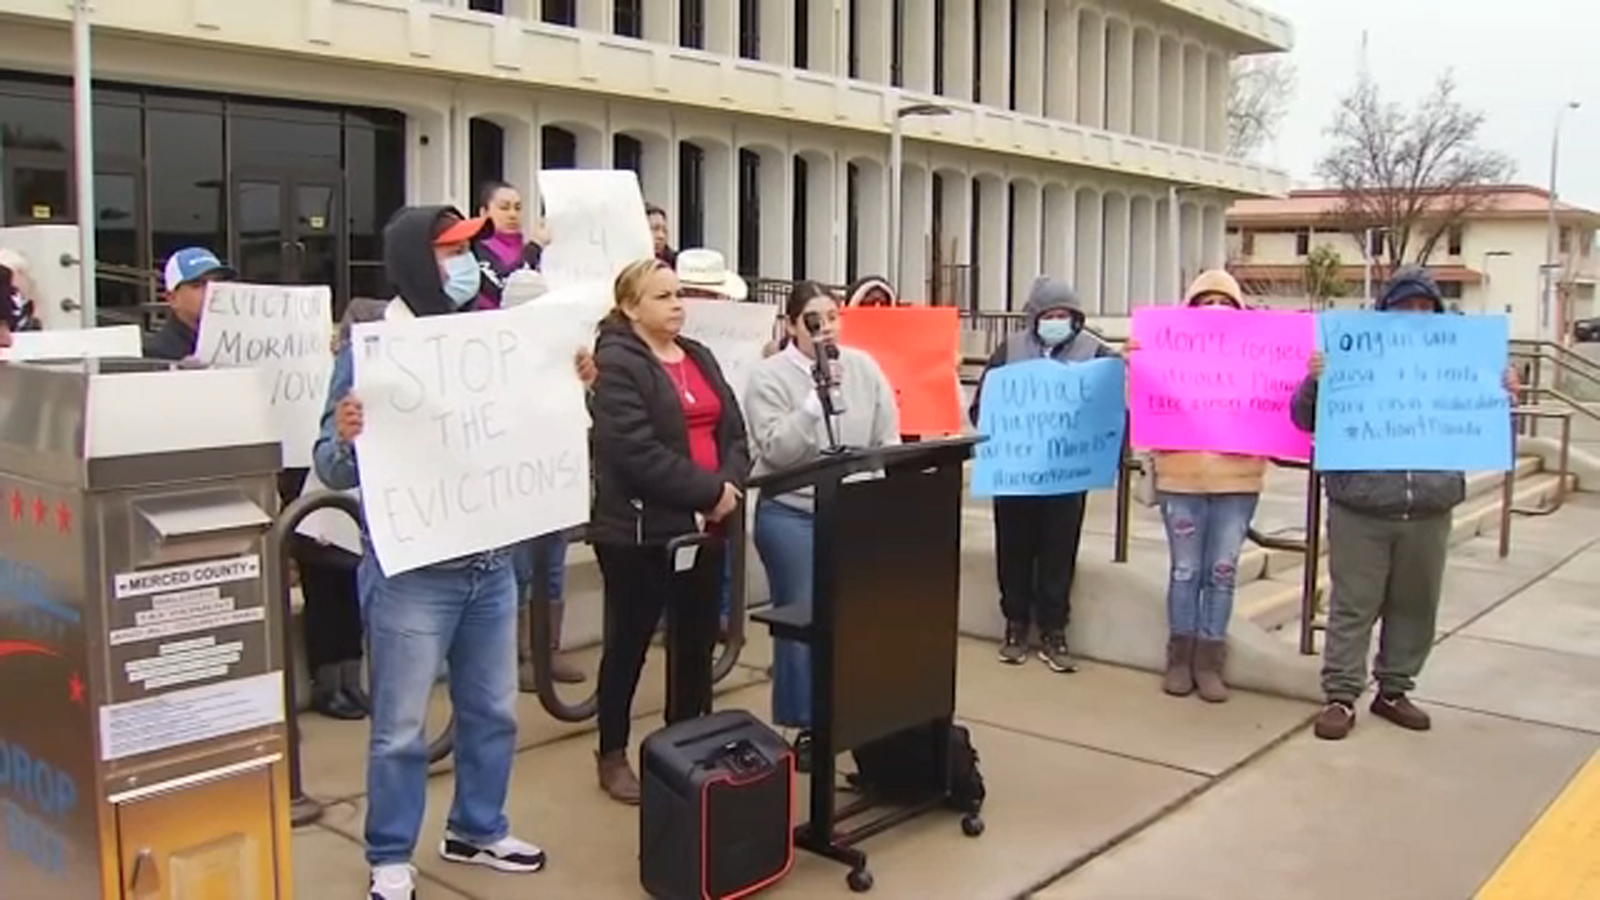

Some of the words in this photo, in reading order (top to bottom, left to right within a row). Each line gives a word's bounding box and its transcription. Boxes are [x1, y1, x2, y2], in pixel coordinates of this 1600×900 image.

[385, 329, 518, 414] STOP
[1001, 372, 1093, 408] What
[431, 401, 507, 452] THE
[383, 450, 580, 545] EVICTIONS
[129, 572, 191, 591] MERCED
[192, 561, 250, 582] COUNTY
